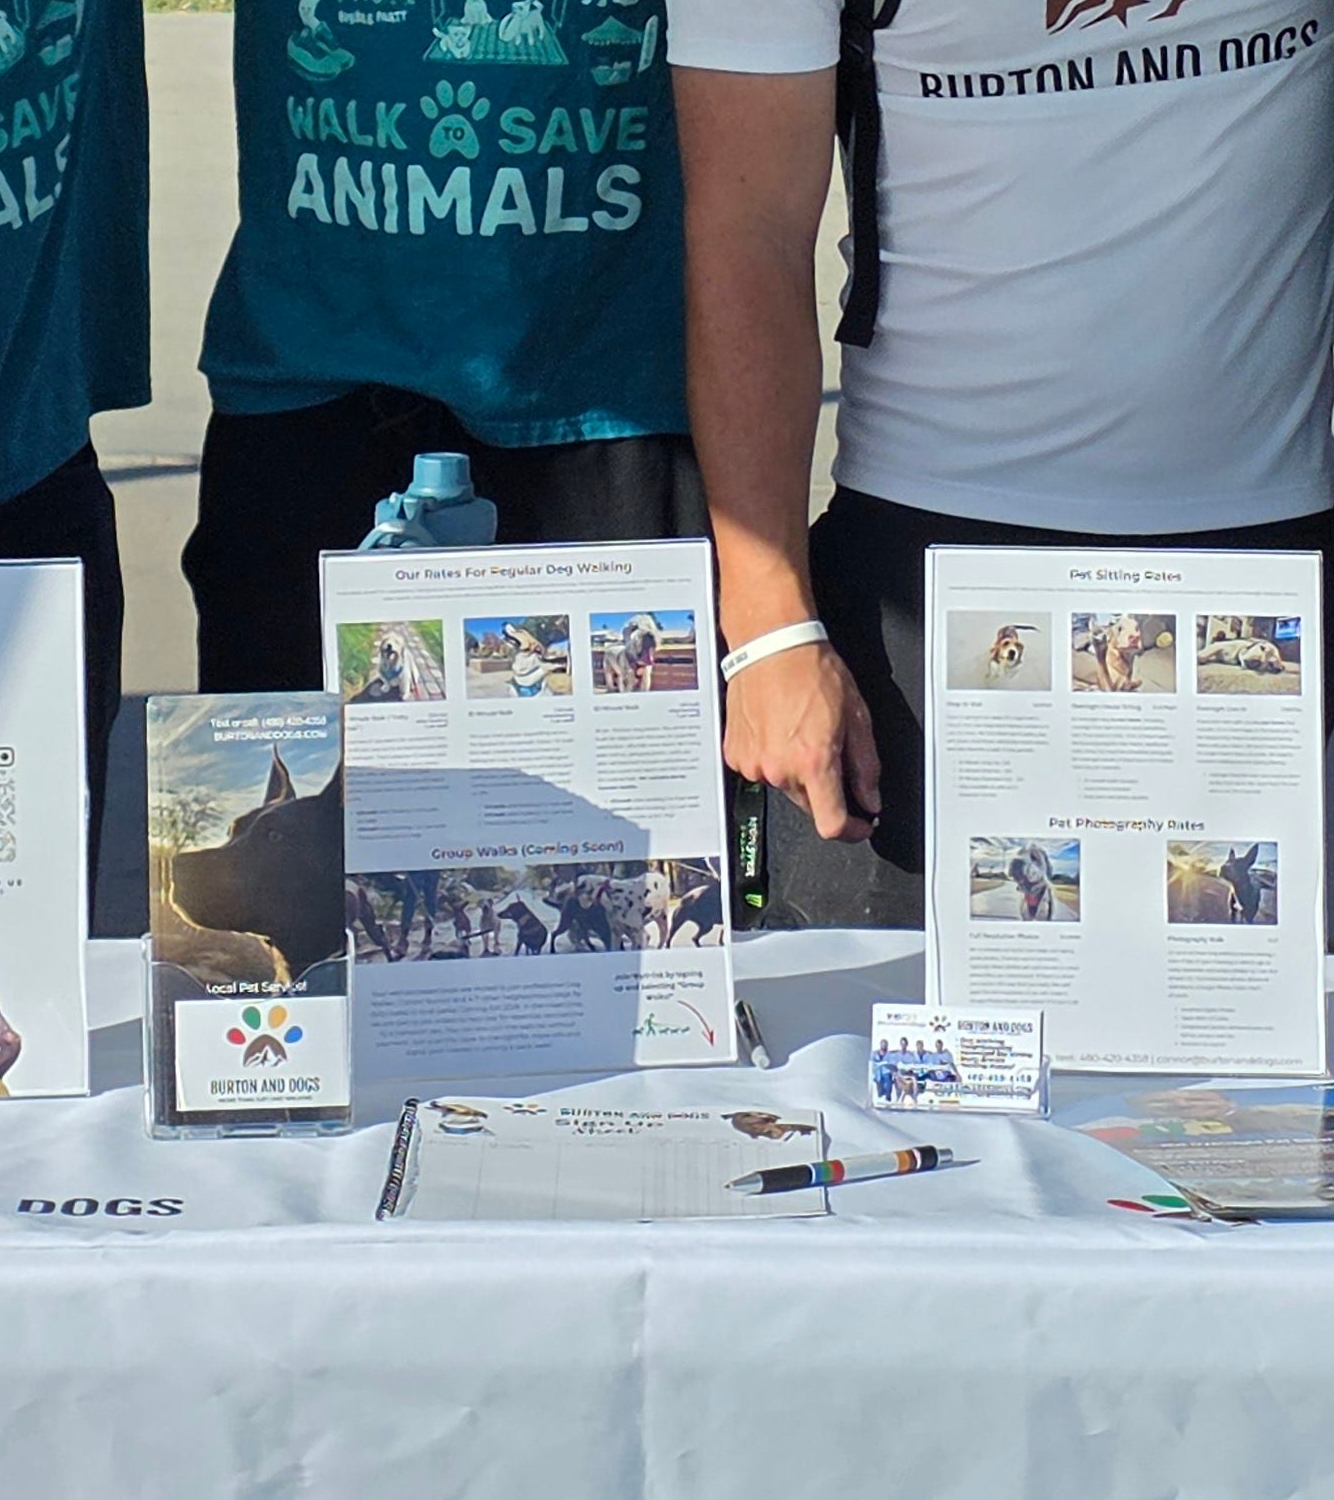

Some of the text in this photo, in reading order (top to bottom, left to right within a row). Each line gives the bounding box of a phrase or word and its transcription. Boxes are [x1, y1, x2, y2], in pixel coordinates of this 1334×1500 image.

[919, 18, 1320, 99] BURTON AND DOGS
[287, 95, 649, 154] WALK TO SAVE
[287, 153, 643, 236] ANIMALS
[395, 560, 634, 582] Our Rates For Regular Dog Walking
[1069, 568, 1183, 583] Pet Sitting Rates
[1049, 817, 1071, 829] Pet
[1075, 817, 1165, 832] Photography
[431, 846, 474, 862] Group
[476, 844, 518, 859] Walks
[521, 840, 579, 859] (Coming
[206, 982, 237, 995] Local
[210, 1076, 321, 1096] BURTON AND DOGS
[16, 1197, 186, 1217] DOGS
